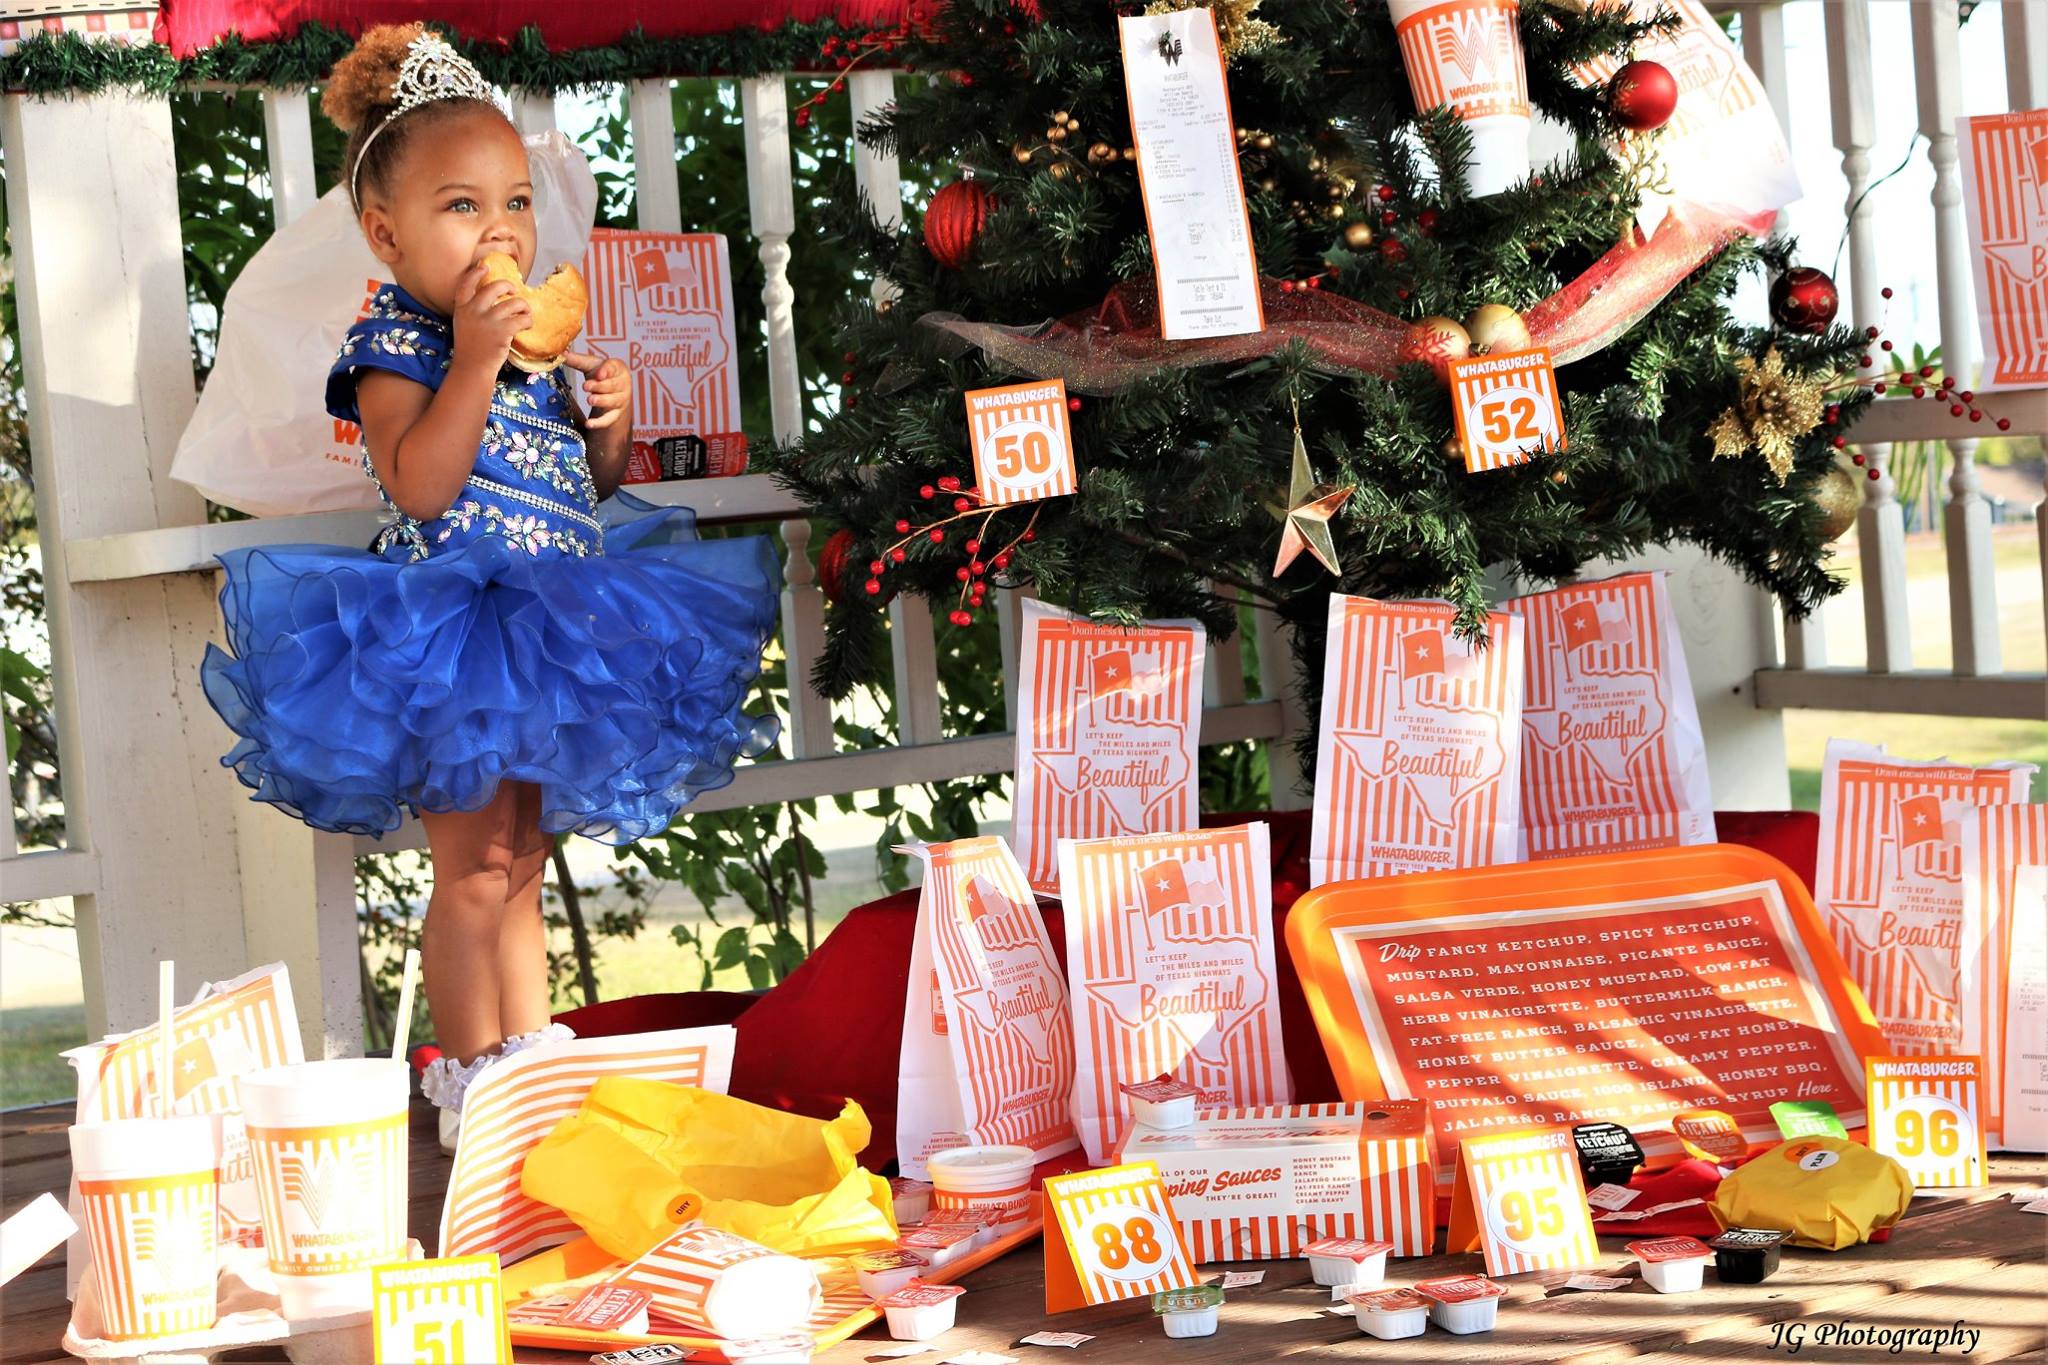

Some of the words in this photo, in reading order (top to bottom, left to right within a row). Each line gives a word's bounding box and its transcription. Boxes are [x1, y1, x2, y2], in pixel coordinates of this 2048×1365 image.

[629, 340, 712, 382] Beautiful
[1456, 353, 1545, 378] WHATABURGER
[973, 386, 1059, 410] WHATABURGER
[1482, 398, 1540, 444] 52
[674, 440, 685, 476] KETCHUP
[995, 431, 1050, 478] 50
[1590, 692, 1610, 700] MILES
[1408, 724, 1422, 732] THE
[1424, 726, 1446, 734] MILES
[1465, 729, 1487, 737] MILES
[1416, 716, 1434, 724] KEEP
[1558, 704, 1647, 757] Beautiful
[1412, 734, 1434, 742] TEXAS
[1437, 736, 1473, 744] HIGHWAYS
[1077, 755, 1170, 805] Beautiful
[1382, 740, 1483, 797] Beautiful
[1371, 846, 1451, 864] WHATABURGER
[1892, 886, 1912, 894] LET'S
[1923, 897, 1946, 905] MILES
[1378, 943, 1422, 962] Drip
[1426, 944, 1488, 957] FANCY
[1600, 928, 1654, 942] SPICY
[1619, 944, 1698, 962] PICANTE
[1879, 911, 1962, 969] Beautif
[1145, 956, 1166, 964] LET'S
[1168, 953, 1188, 961] KEEP
[1162, 963, 1175, 971] THE
[1178, 962, 1201, 970] MILES
[1203, 960, 1218, 968] AND
[1221, 958, 1244, 967] MILES
[1167, 972, 1192, 980] TEXAS
[1194, 968, 1232, 978] HIGHWAYS
[1394, 990, 1455, 1004] SALSA
[1530, 978, 1591, 993] HONEY
[1695, 958, 1770, 976] LOW-FAT
[988, 976, 1054, 1031] Beautiful
[1140, 976, 1246, 1032] Beautiful
[1402, 1014, 1450, 1026] HERB
[1595, 986, 1714, 1008] BUTTERMILK
[1409, 1031, 1496, 1047] FAT-FREE
[1574, 1013, 1665, 1032] BALSAMIC
[1418, 1053, 1482, 1069] HONEY
[1490, 1046, 1568, 1063] BUTTER
[1652, 1028, 1730, 1046] LOW-FAT
[1738, 1019, 1800, 1036] HONEY
[1426, 1075, 1501, 1089] PEPPER
[1652, 1050, 1730, 1068] CREAMY
[1873, 1062, 1976, 1078] WHATABURGER
[1435, 1095, 1518, 1110] BUFFALO
[1593, 1083, 1634, 1096] 1000
[1718, 1066, 1780, 1082] HONEY
[1443, 1114, 1546, 1132] JALAPEÑO
[1630, 1096, 1720, 1114] PANCAKE
[1726, 1088, 1788, 1104] SYRUP
[1678, 1118, 1732, 1136] PICANTE
[1576, 1134, 1628, 1149] KETCHUP
[1895, 1109, 1960, 1158] 96
[1206, 1192, 1242, 1202] THEY'RE
[1245, 1192, 1278, 1200] GREAT!
[1212, 1168, 1282, 1192] Sauces
[676, 1201, 692, 1216] DRY
[1502, 1186, 1565, 1242] 95
[1092, 1217, 1162, 1270] 88
[1639, 1241, 1697, 1256] KETCHUP
[587, 1288, 632, 1325] KETCHUP
[414, 1319, 465, 1364] 51
